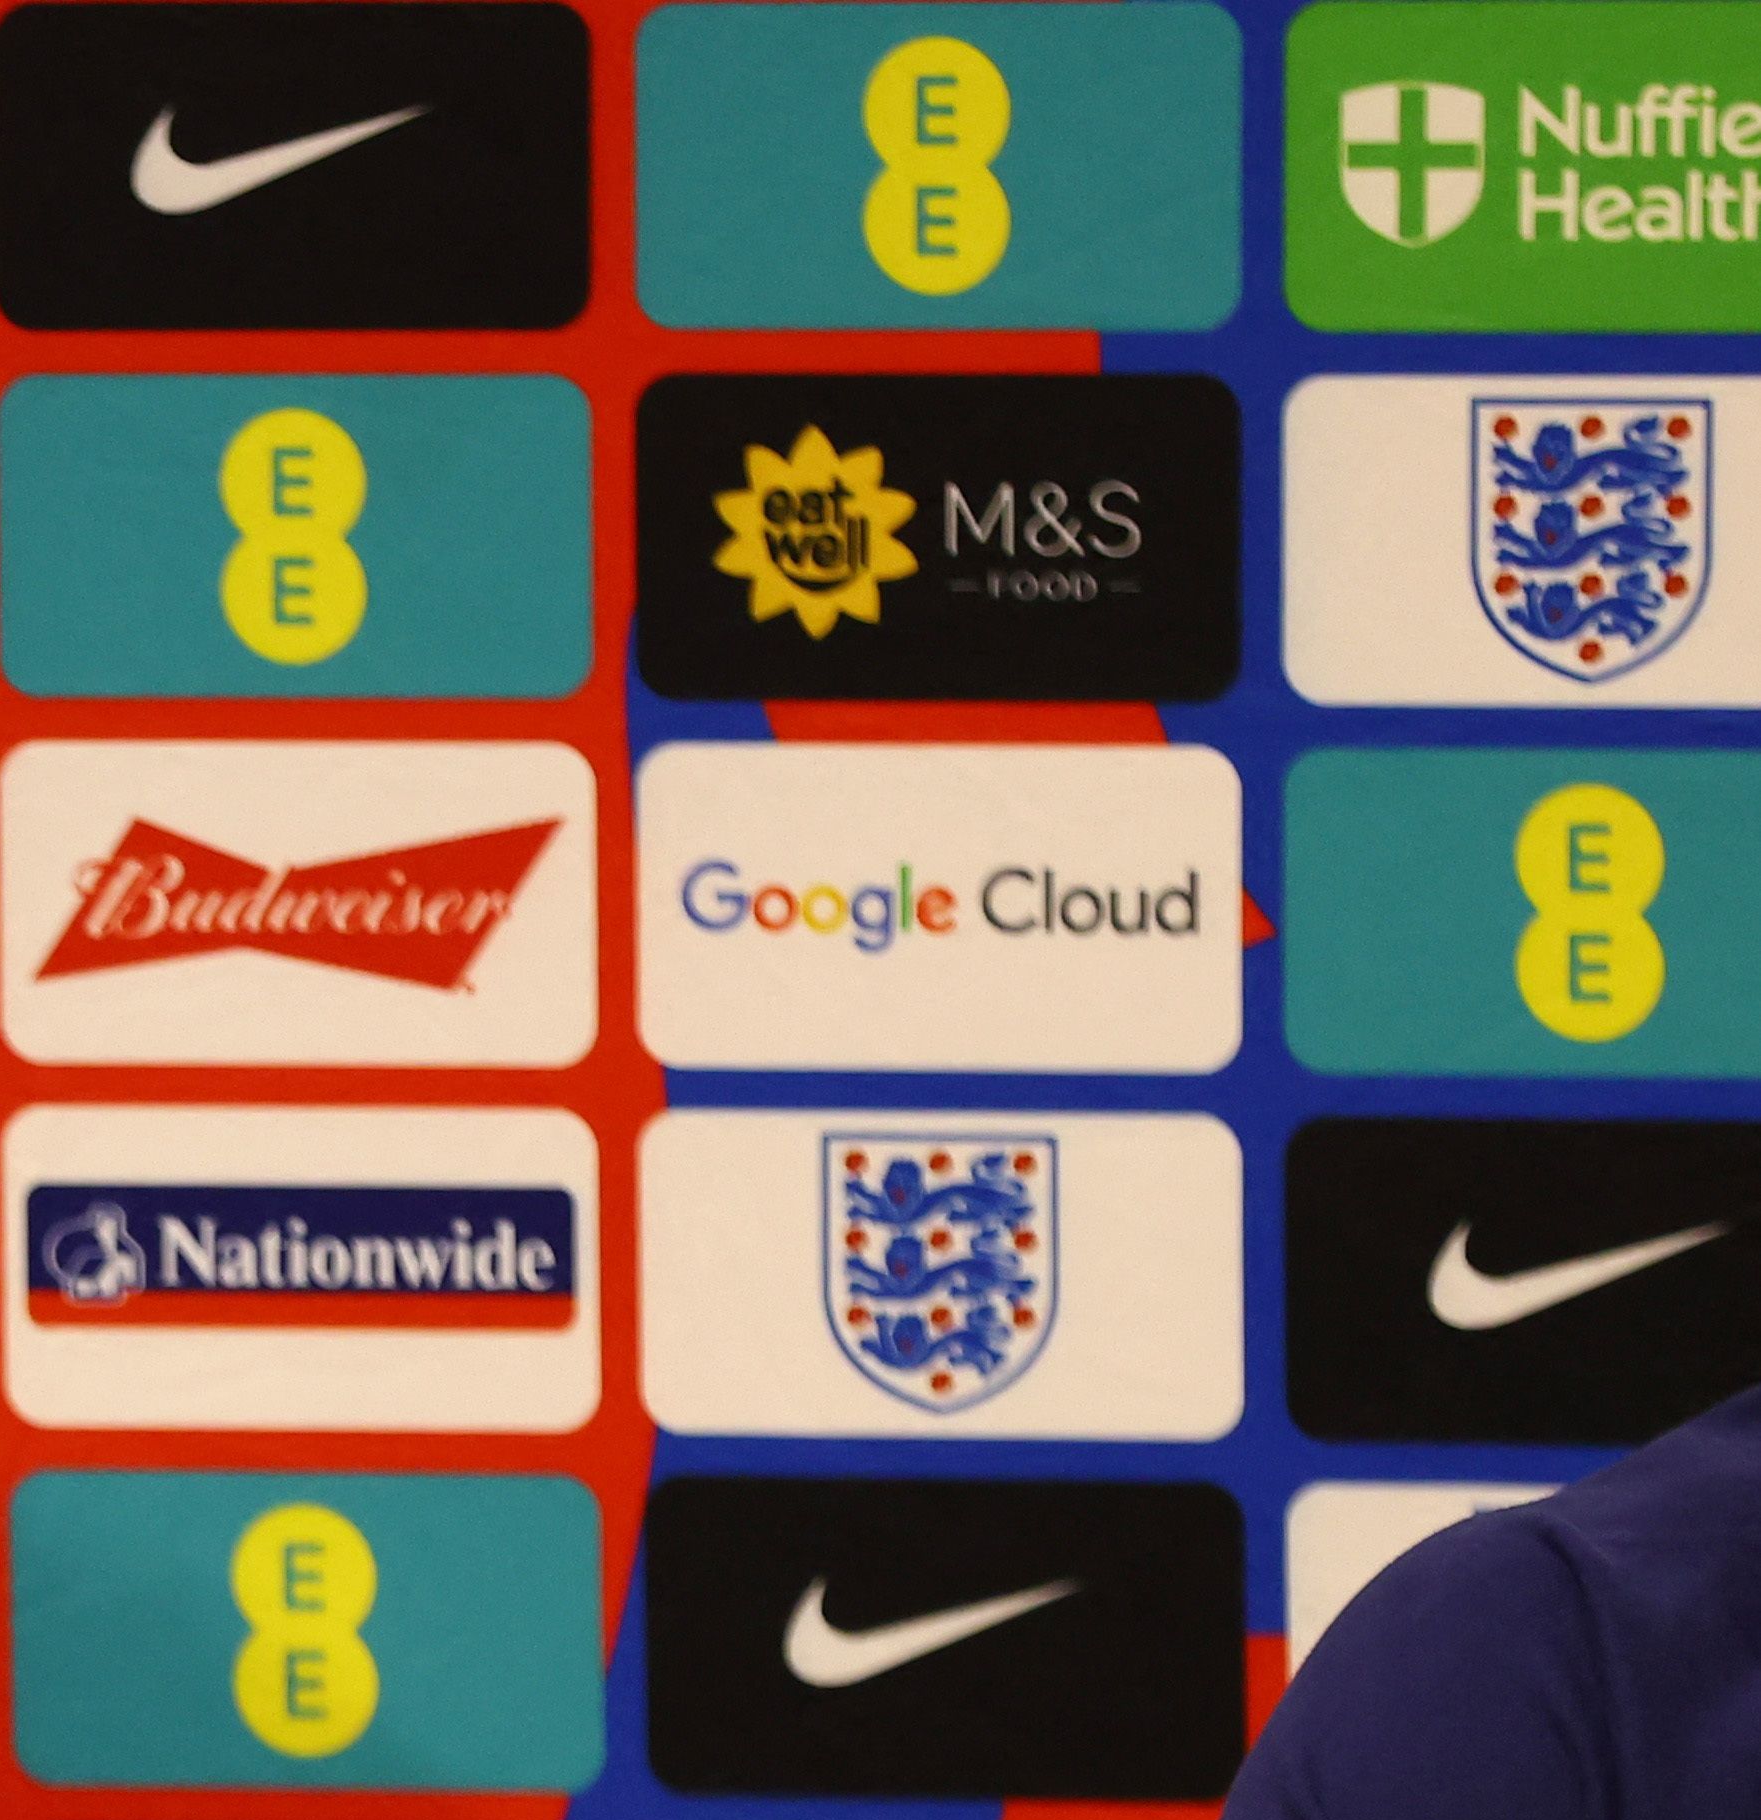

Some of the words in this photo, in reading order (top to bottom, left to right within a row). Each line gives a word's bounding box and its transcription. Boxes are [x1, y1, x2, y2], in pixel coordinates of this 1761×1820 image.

[764, 477, 853, 525] eat
[943, 479, 1142, 558] M&S
[764, 516, 870, 569] well
[75, 853, 514, 938] Budweiser
[680, 860, 958, 952] Google
[981, 867, 1200, 934] Cloud
[157, 1216, 557, 1291] Nationwide
